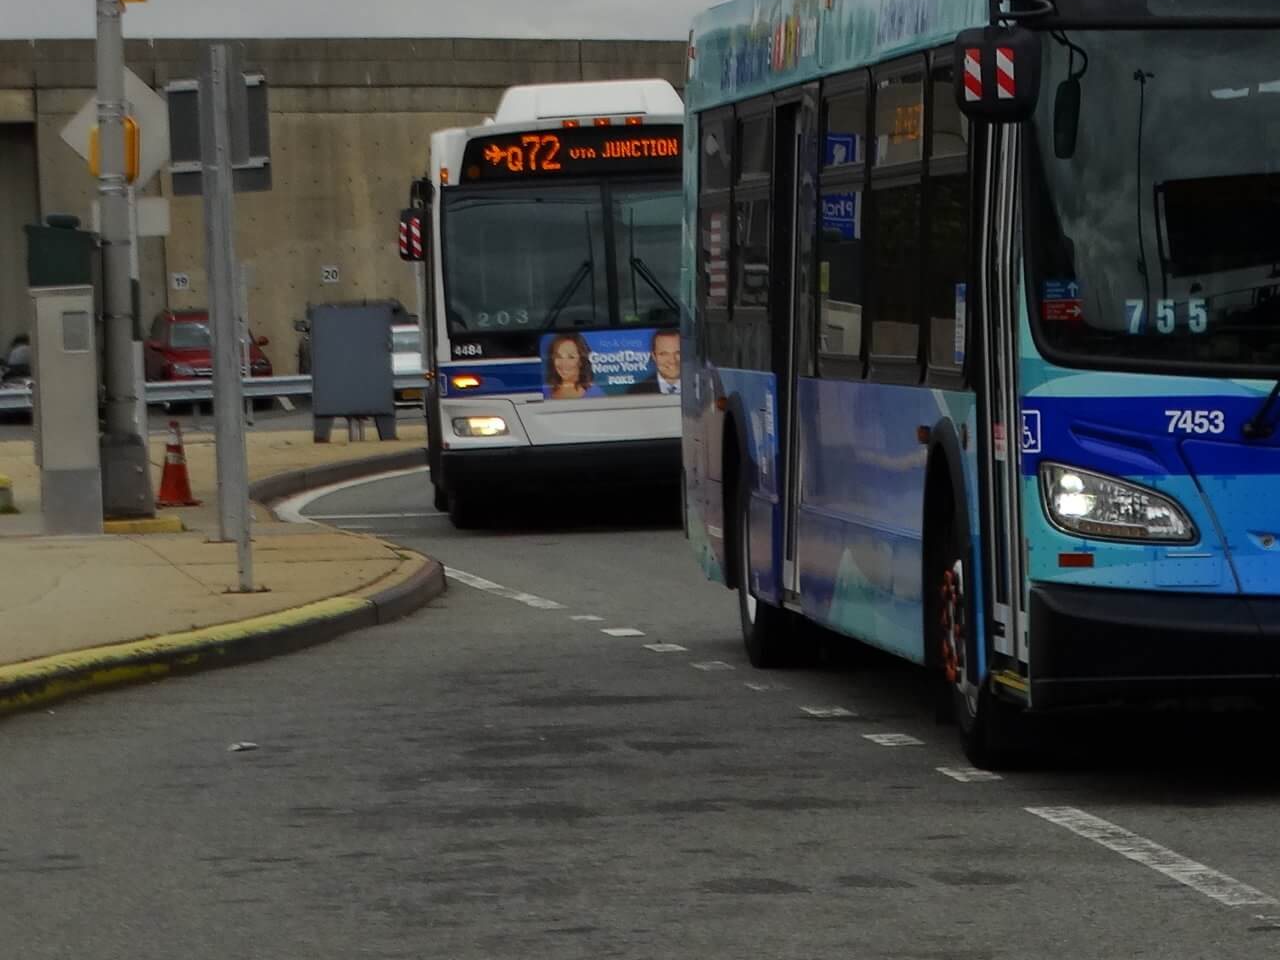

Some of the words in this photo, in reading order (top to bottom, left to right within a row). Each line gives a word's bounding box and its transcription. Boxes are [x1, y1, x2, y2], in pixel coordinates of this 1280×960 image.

[507, 134, 562, 173] Q72
[601, 138, 679, 158] JUNCTION
[323, 269, 339, 281] 20
[454, 344, 483, 356] 4484
[1165, 410, 1225, 434] 7453
